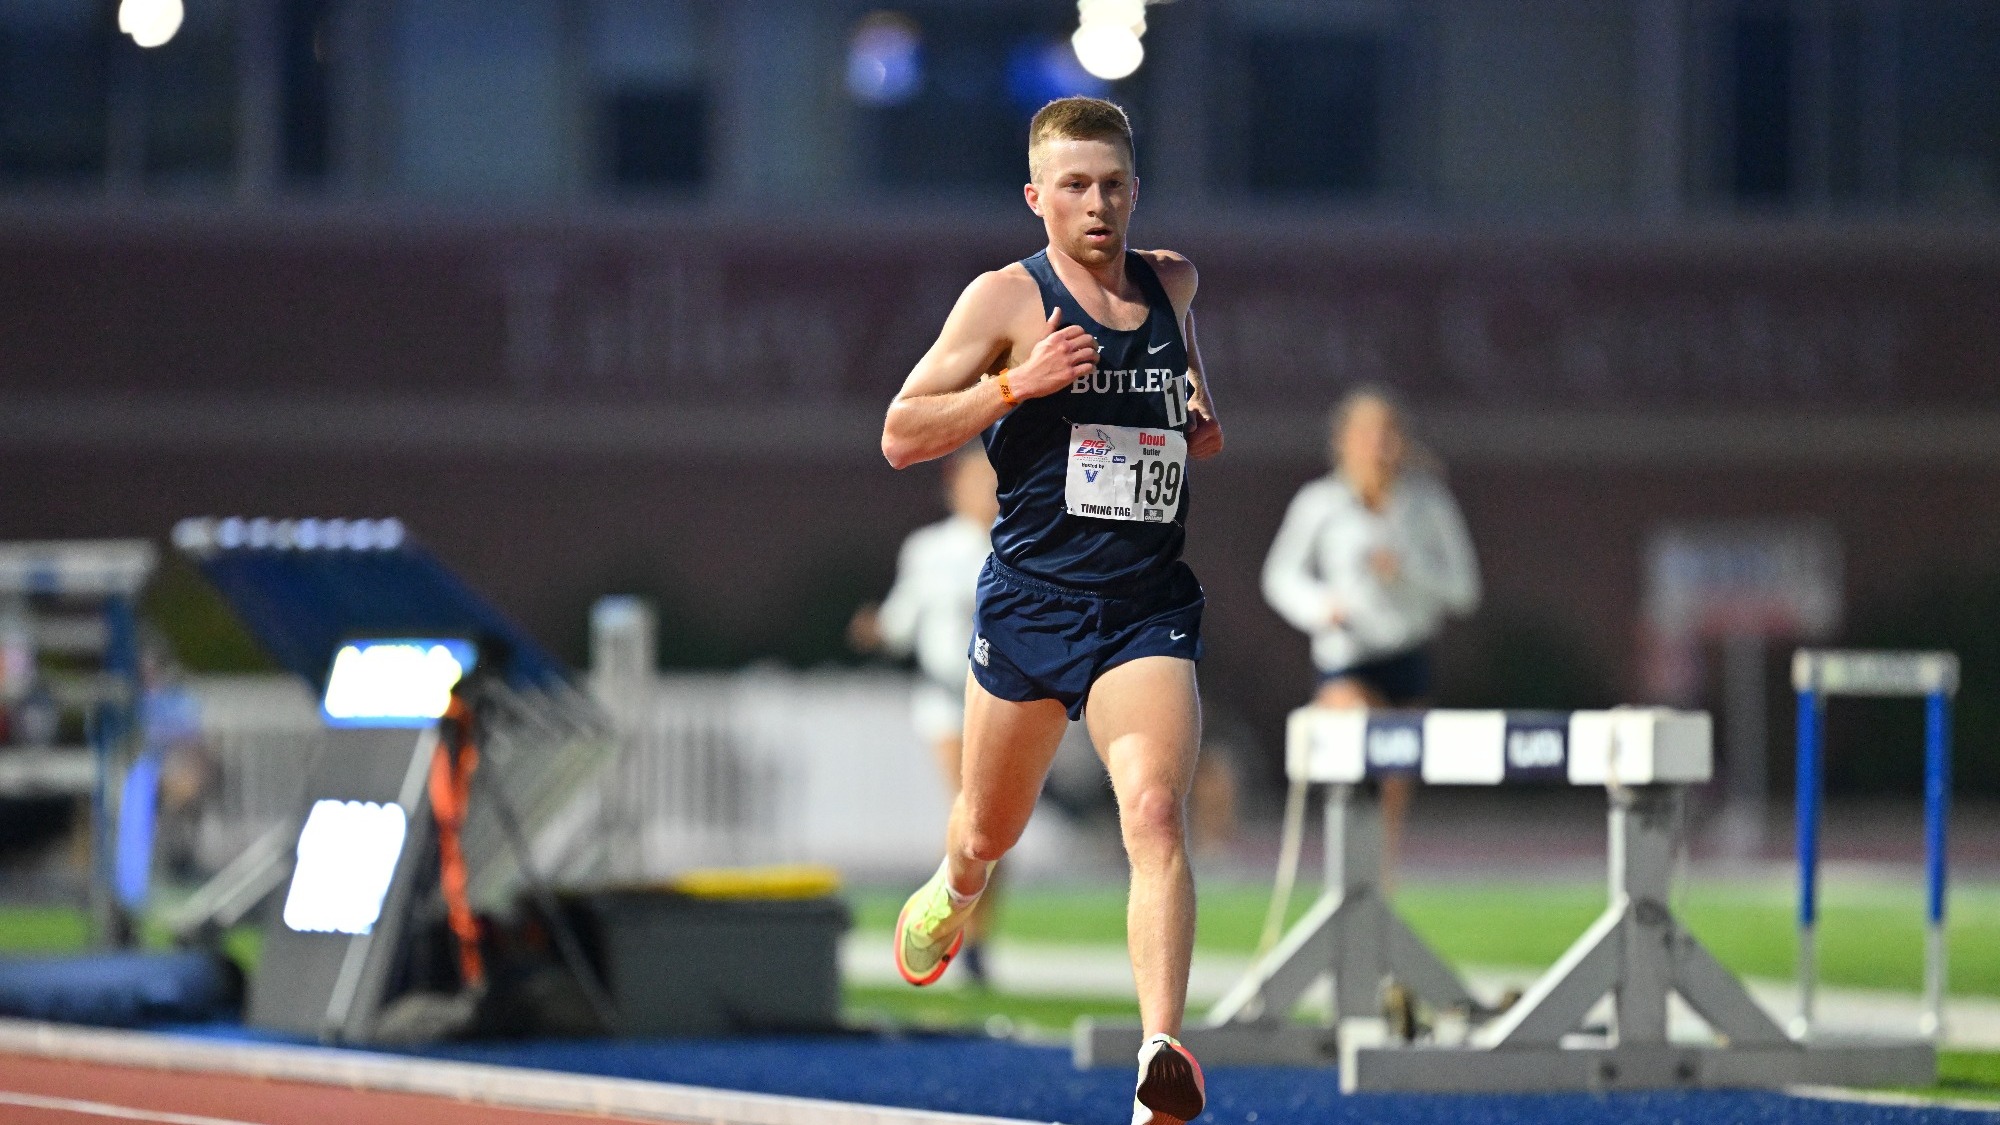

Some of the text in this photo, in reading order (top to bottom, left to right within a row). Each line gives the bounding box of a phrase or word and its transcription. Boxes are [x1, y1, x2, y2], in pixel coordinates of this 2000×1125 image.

[1166, 378, 1182, 423] 1
[1081, 439, 1106, 448] BIG
[1139, 432, 1166, 446] Doud
[1076, 446, 1111, 456] EAST
[1142, 448, 1161, 456] Butler
[1130, 460, 1180, 506] 139
[1081, 503, 1131, 517] TIMING TAG
